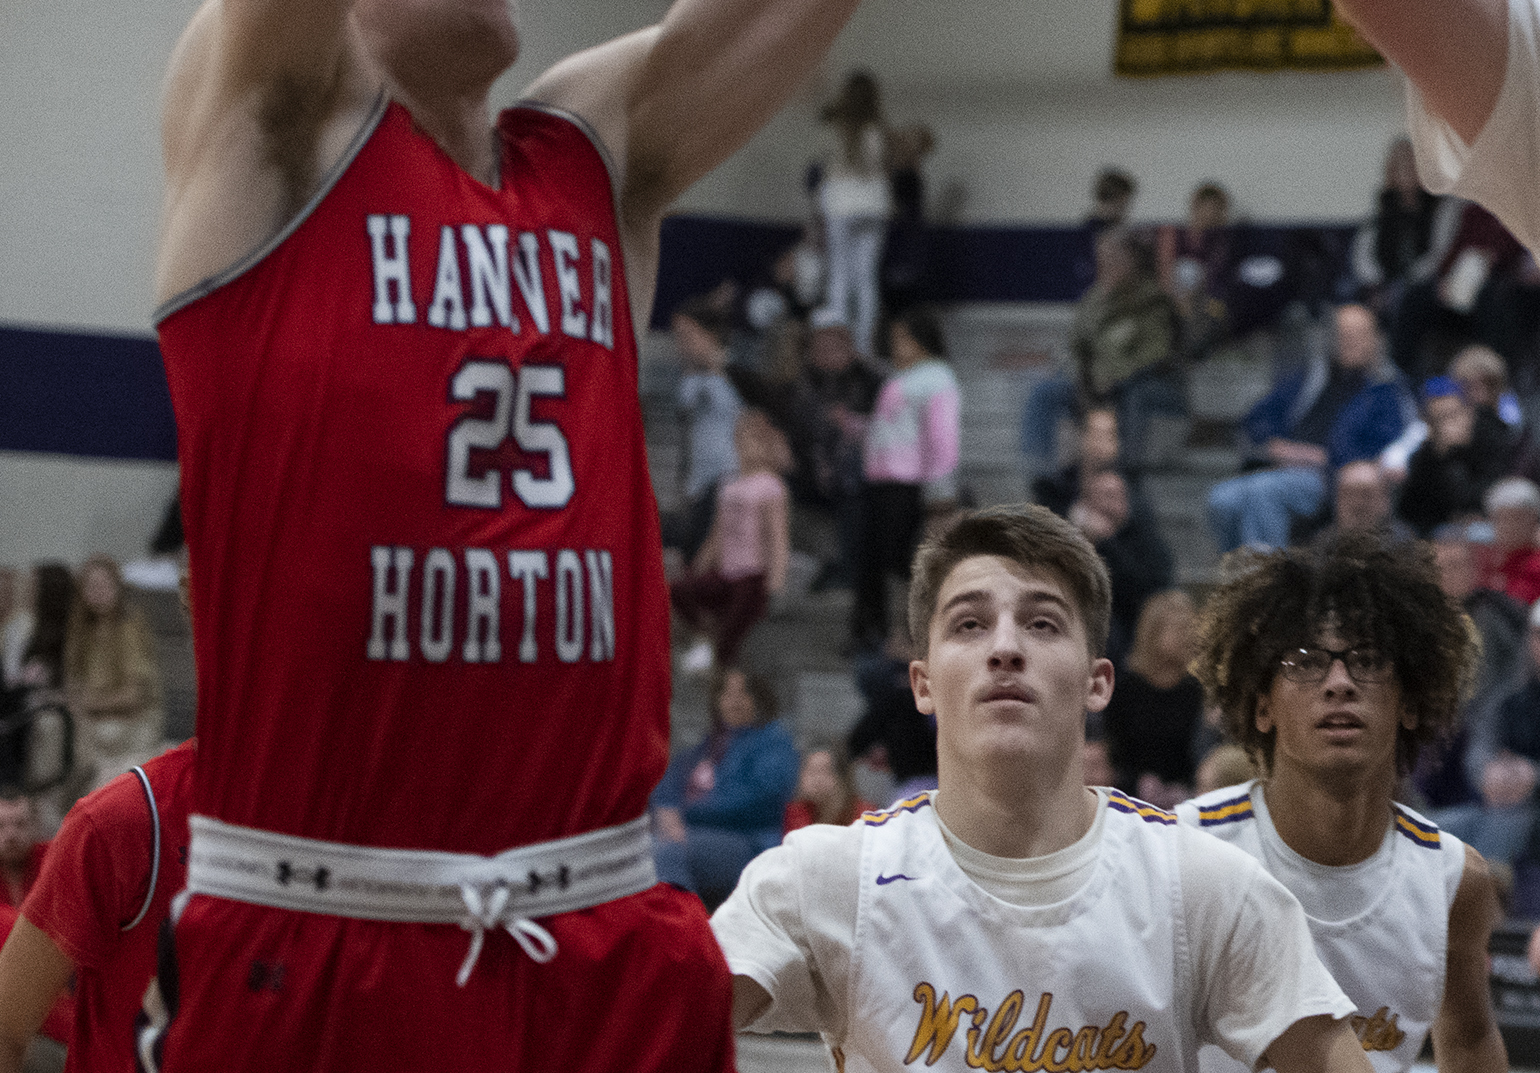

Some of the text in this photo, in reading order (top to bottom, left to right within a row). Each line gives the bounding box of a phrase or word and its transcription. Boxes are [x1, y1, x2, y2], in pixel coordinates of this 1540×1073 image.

[444, 358, 578, 509] 25
[365, 545, 617, 663] HORTON
[902, 980, 1157, 1073] Wildcats
